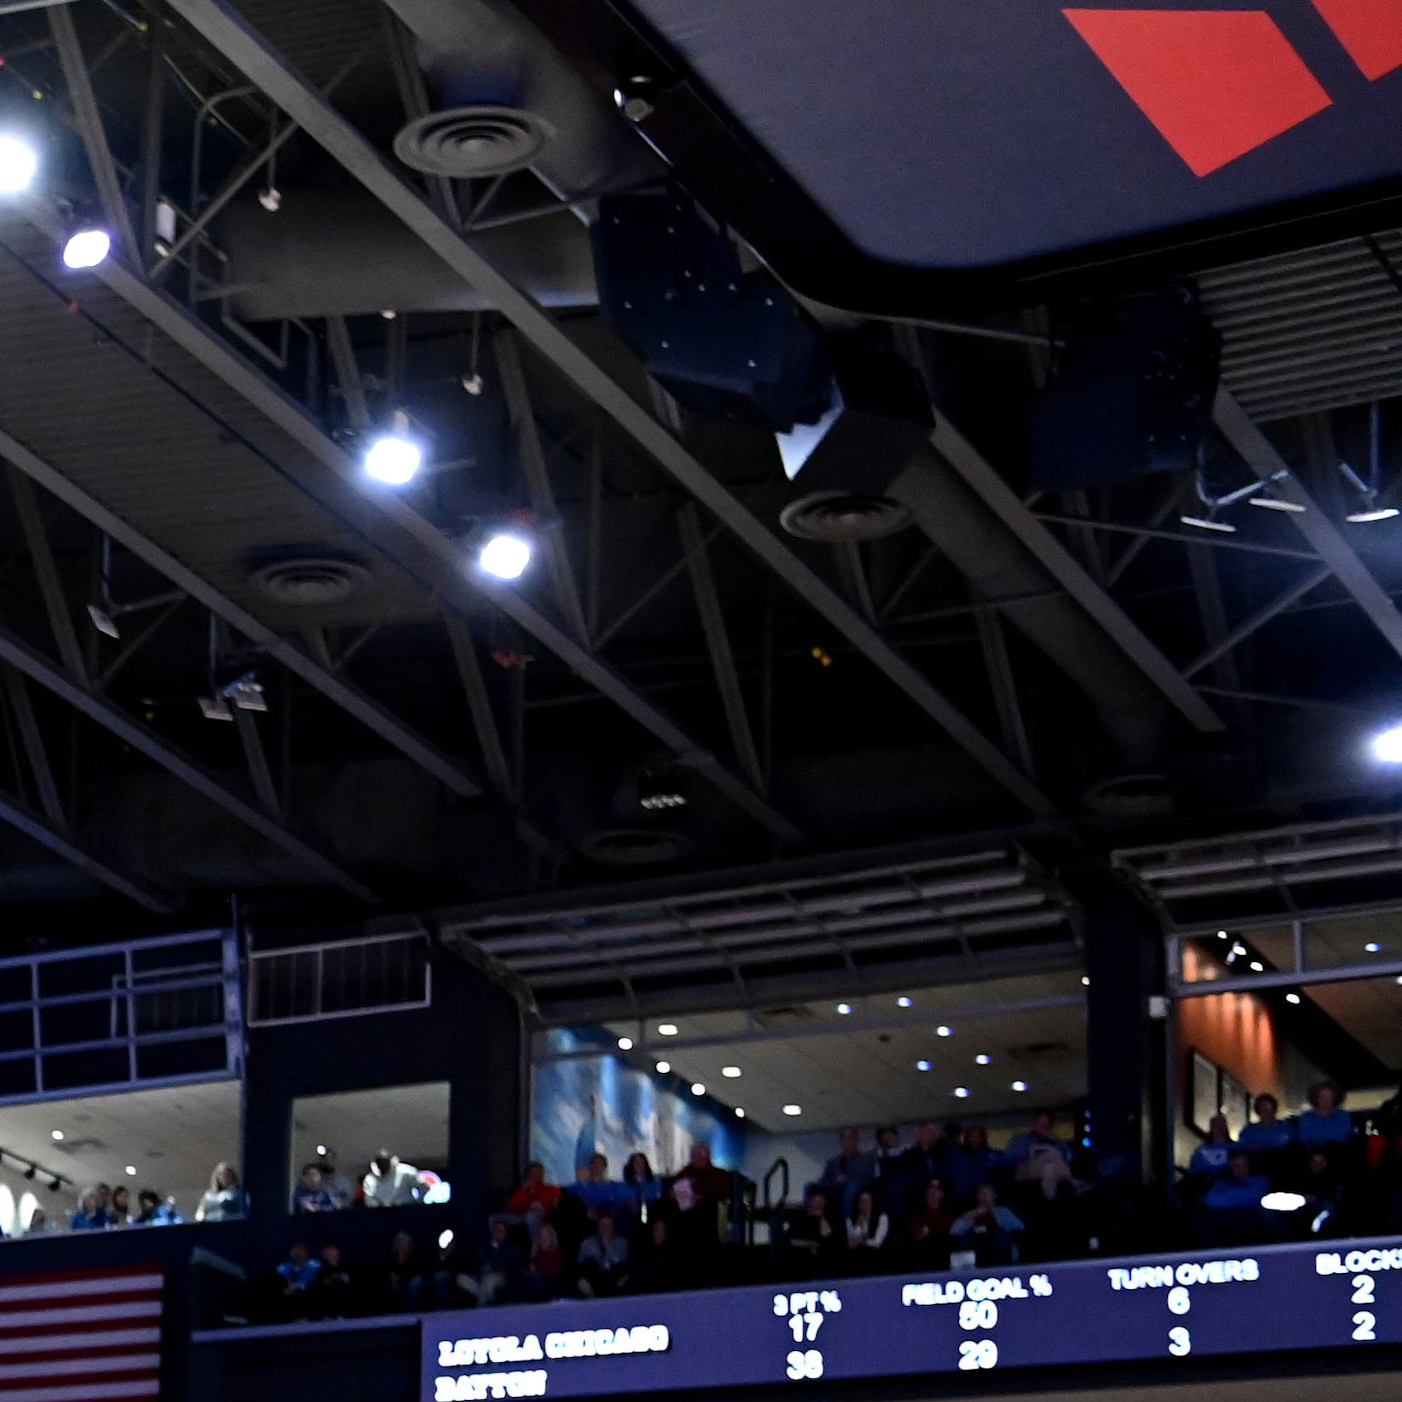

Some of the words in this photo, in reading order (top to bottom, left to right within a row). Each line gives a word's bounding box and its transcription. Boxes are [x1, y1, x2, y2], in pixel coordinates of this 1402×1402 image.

[1107, 1265, 1173, 1290] TURN
[1175, 1258, 1260, 1285] OVERS
[1315, 1249, 1402, 1275] BLOCK
[902, 1283, 964, 1306] FIELD
[966, 1278, 1028, 1301] GOAL
[1167, 1286, 1191, 1314] 6
[1351, 1274, 1375, 1303] 2
[788, 1312, 823, 1342] 17
[958, 1299, 998, 1330] 50
[1351, 1311, 1376, 1340] 2
[1168, 1326, 1191, 1356] 3
